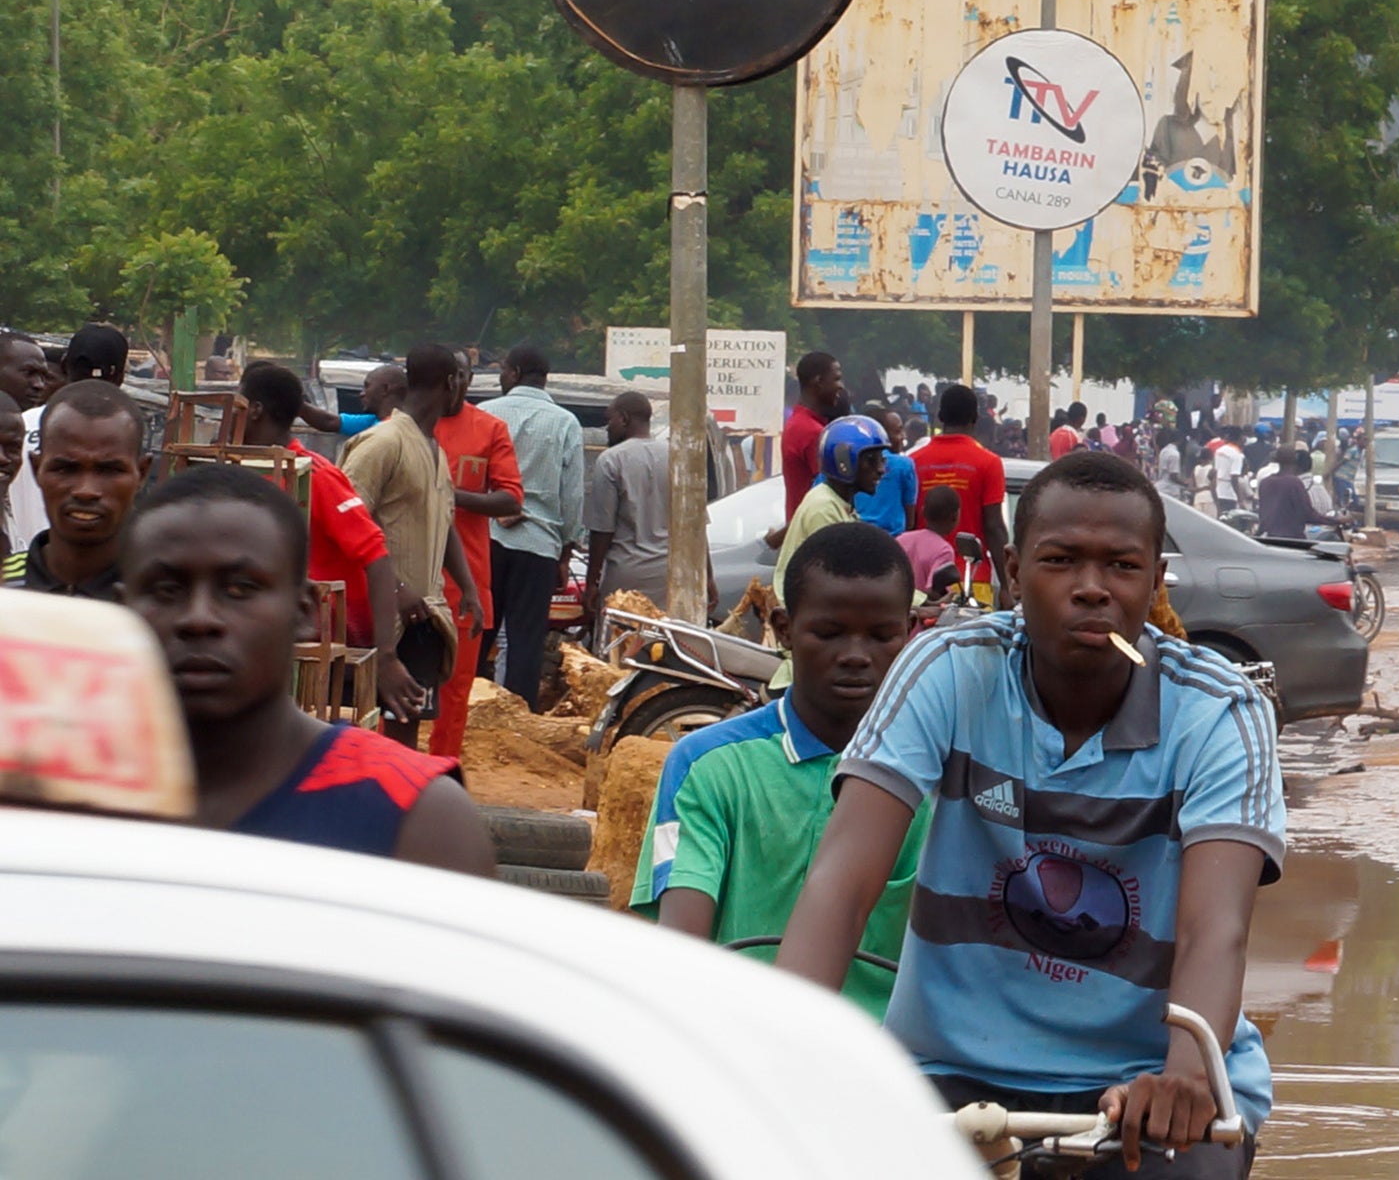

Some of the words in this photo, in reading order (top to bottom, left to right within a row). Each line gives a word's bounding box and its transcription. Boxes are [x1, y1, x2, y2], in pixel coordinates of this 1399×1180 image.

[986, 138, 1096, 170] TAMBARIN
[1002, 160, 1072, 185] HAUSA
[995, 187, 1043, 206] CANAL
[1046, 194, 1071, 209] 289
[717, 372, 735, 384] DE
[974, 793, 1020, 818] adidas
[1024, 952, 1089, 984] Niger
